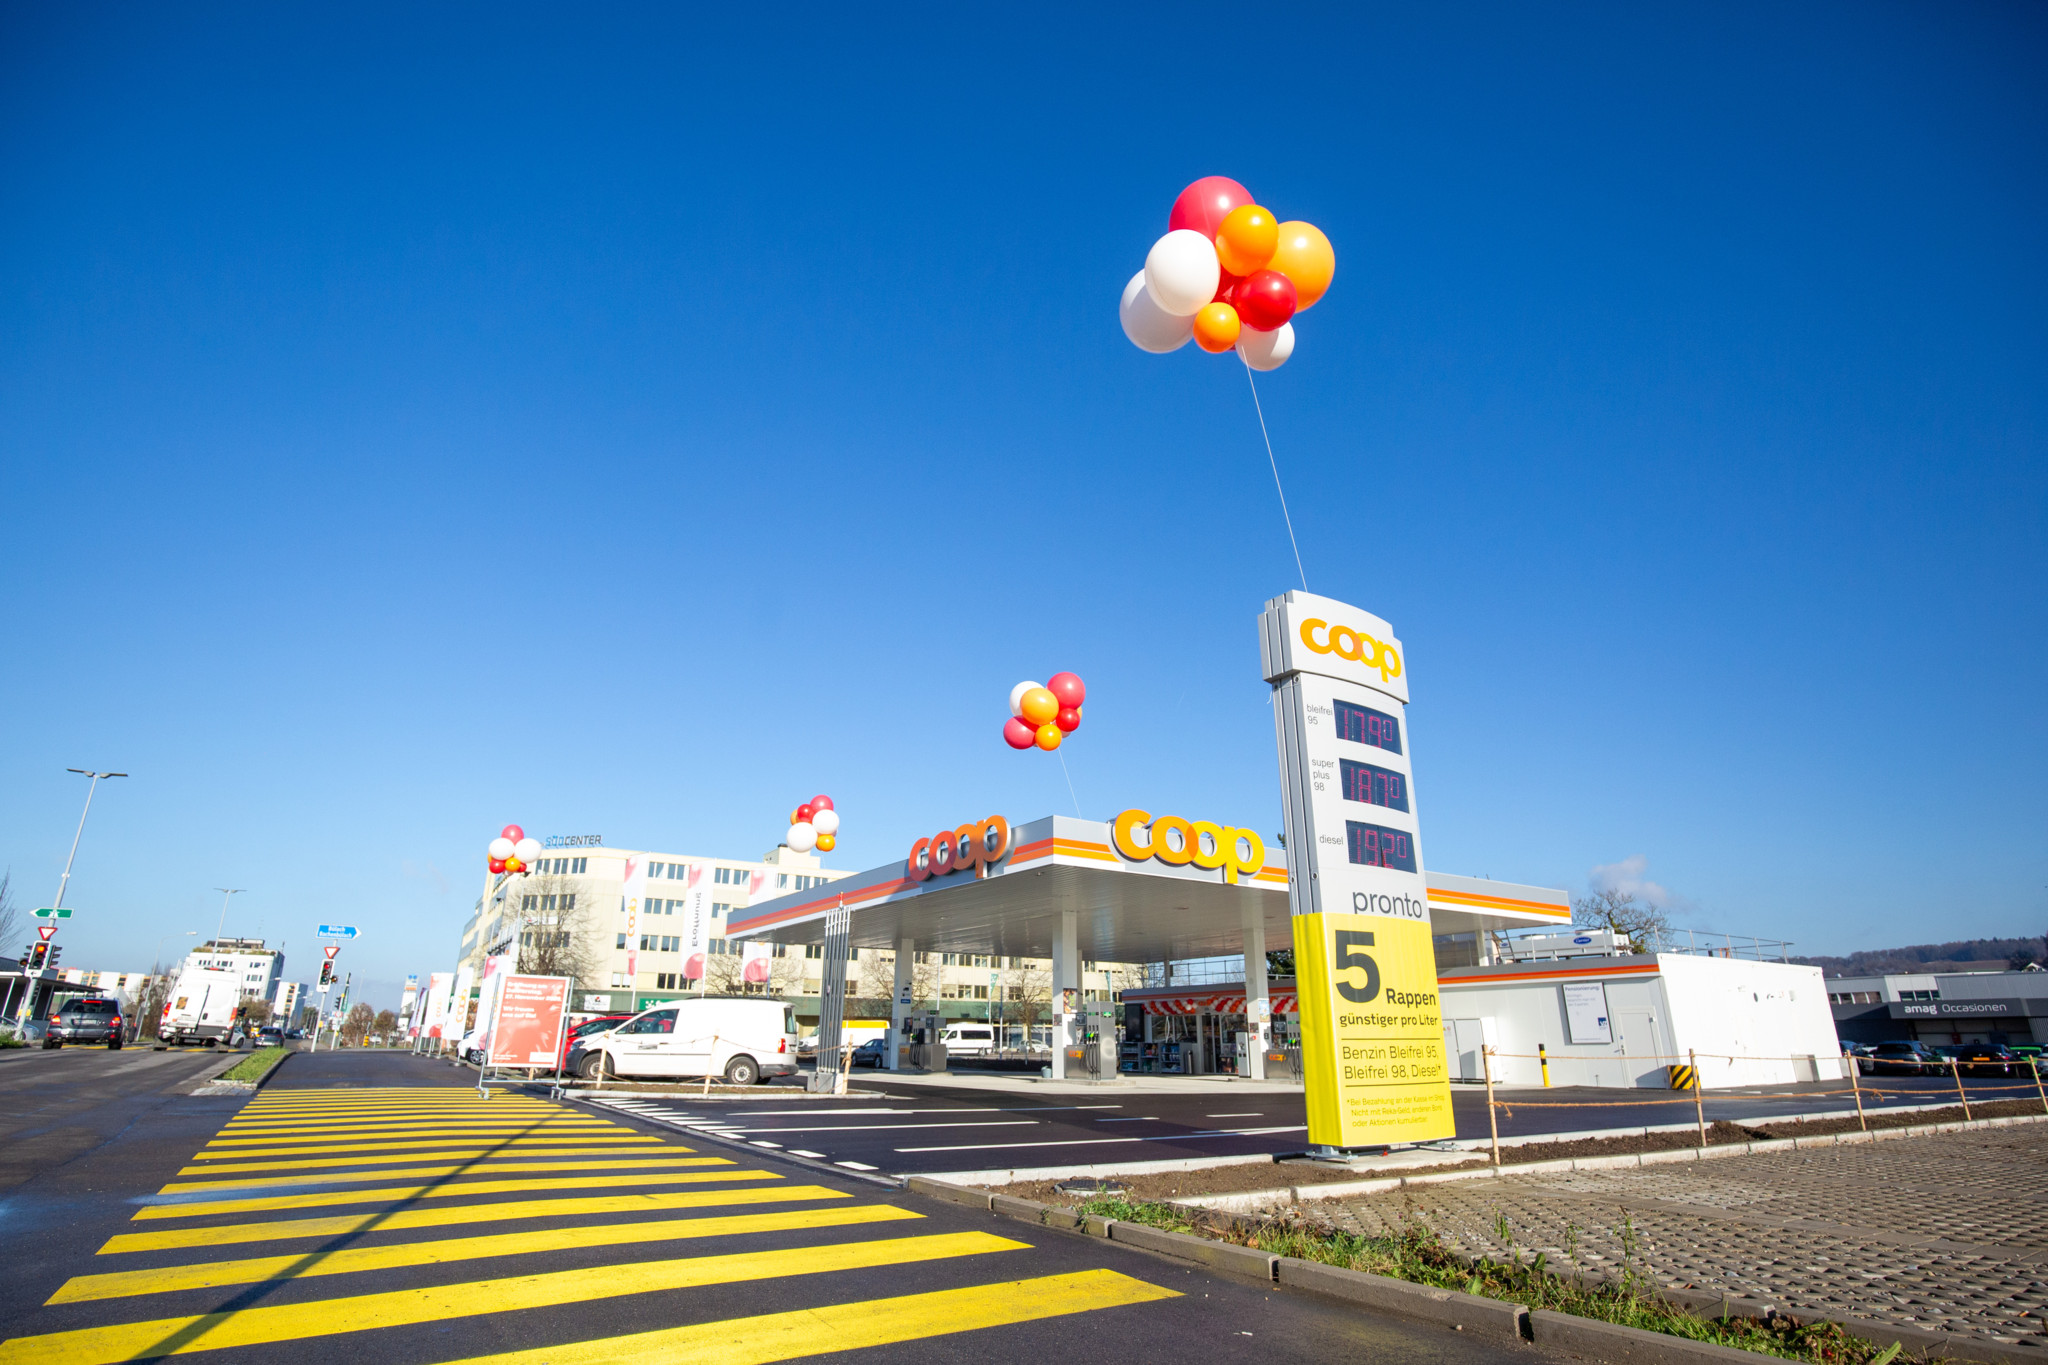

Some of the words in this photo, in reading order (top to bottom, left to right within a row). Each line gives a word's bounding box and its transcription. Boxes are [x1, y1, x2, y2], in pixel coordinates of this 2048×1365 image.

[1300, 617, 1402, 683] coop
[1306, 704, 1333, 716] bleifrei
[1307, 715, 1319, 725] 95
[1311, 758, 1334, 769] super
[1312, 769, 1330, 781] plus
[1313, 781, 1325, 791] 98
[545, 835, 602, 847] SÜDCENTER
[1114, 809, 1265, 884] coop
[1319, 834, 1344, 846] diesel
[908, 814, 1009, 881] coop
[1352, 890, 1422, 919] pronto
[627, 897, 638, 937] coop
[1335, 929, 1380, 1003] 5
[1386, 988, 1437, 1009] Rappen
[1904, 1004, 1938, 1015] amag
[1942, 1003, 2007, 1013] Occasionen
[1339, 1013, 1398, 1027] günstiger
[1401, 1016, 1417, 1027] pro
[1419, 1013, 1438, 1026] Liter
[1342, 1046, 1386, 1059] Benzin
[1389, 1045, 1424, 1059] Bleifrei
[1426, 1045, 1439, 1059] 95,
[1344, 1065, 1388, 1079] Bleifrei
[1392, 1065, 1409, 1079] 98,
[1351, 1109, 1368, 1117] Nicht
